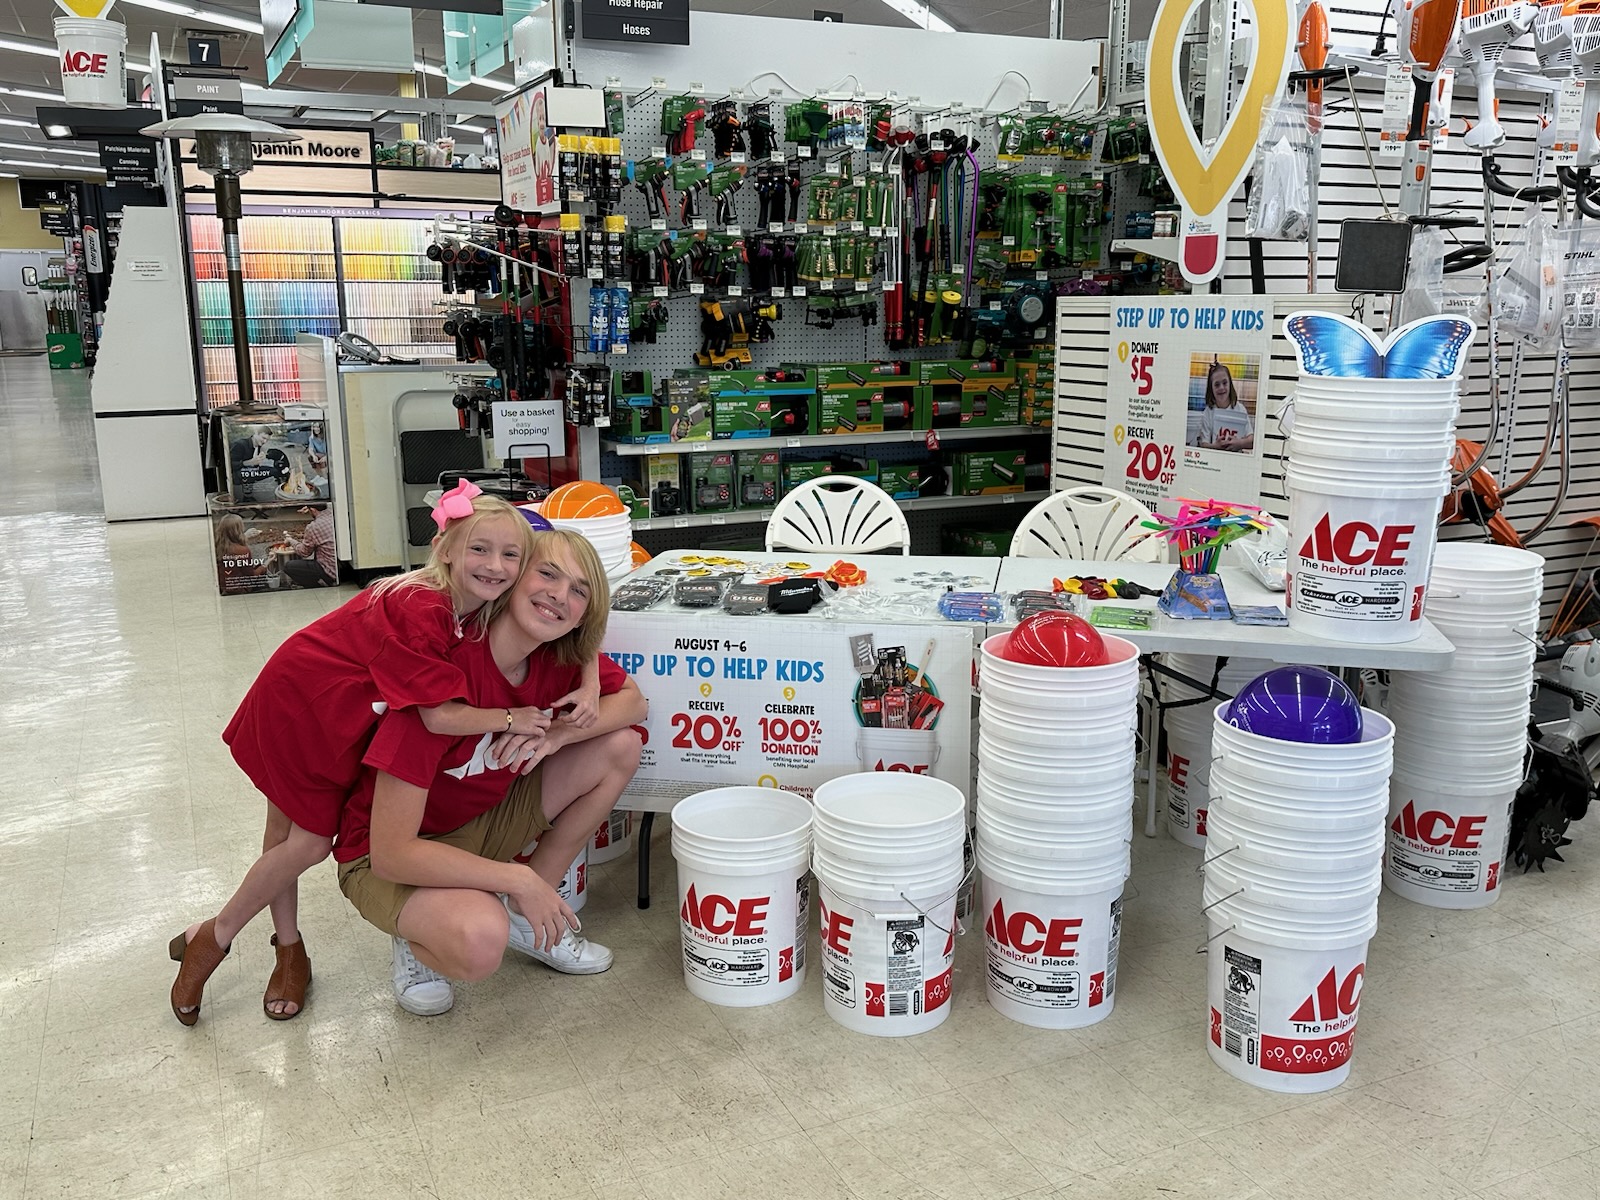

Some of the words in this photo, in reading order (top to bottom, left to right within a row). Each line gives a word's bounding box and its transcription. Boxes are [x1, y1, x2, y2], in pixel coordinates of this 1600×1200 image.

[634, 0, 663, 10] Repair
[623, 23, 651, 36] Hoses
[198, 43, 210, 62] 7
[63, 48, 108, 74] ACE
[197, 85, 220, 94] PAINT
[202, 105, 218, 113] Paint
[251, 142, 304, 158] njamin
[308, 142, 361, 158] Moore
[47, 191, 57, 200] 16
[88, 235, 97, 267] Energizer
[1563, 251, 1595, 260] STIHL
[1116, 307, 1144, 329] STEP
[1149, 307, 1165, 329] UP
[1170, 307, 1189, 329] TO
[1194, 307, 1226, 330] HELP
[1231, 309, 1264, 331] KIDS
[1131, 342, 1158, 354] DONATE
[1131, 355, 1154, 396] $5
[500, 409, 518, 417] Use
[526, 408, 555, 416] basket
[508, 426, 550, 436] shopping!
[1128, 426, 1154, 439] RECEIVE
[1126, 439, 1176, 481] 20%
[1298, 511, 1416, 566] ACE
[222, 552, 249, 560] designed
[223, 560, 235, 568] TO
[237, 558, 265, 567] ENJOY
[1301, 558, 1318, 570] The
[1321, 563, 1366, 576] helpful
[1370, 567, 1406, 577] place.
[781, 587, 814, 596] Milwaukee
[1339, 594, 1360, 604] ACE
[674, 638, 720, 651] AUGUST
[604, 652, 645, 675] TEP
[653, 654, 677, 676] UP
[686, 656, 715, 678] TO
[723, 657, 768, 680] HELP
[776, 659, 824, 683] KIDS
[688, 700, 725, 711] RECEIVE
[765, 703, 815, 715] CELEBRATE
[671, 712, 742, 750] 20%
[758, 717, 822, 743] 100%
[761, 742, 818, 756] DONATION
[704, 752, 731, 760] everything
[780, 784, 813, 793] Children's
[1391, 799, 1487, 849] ACE
[1392, 832, 1406, 844] The
[1408, 839, 1445, 855] helpful
[1448, 849, 1480, 857] place.
[1422, 867, 1439, 877] ACE
[681, 882, 770, 936] ACE
[985, 897, 1083, 957] ACE
[694, 928, 728, 945] helpful
[732, 937, 767, 946] place.
[827, 947, 853, 966] place.
[1000, 945, 1037, 965] helpful
[1041, 957, 1078, 967] place.
[709, 960, 726, 971] ACE
[1016, 979, 1033, 991] ACE
[1288, 962, 1365, 1022] AC
[1293, 1022, 1320, 1033] The
